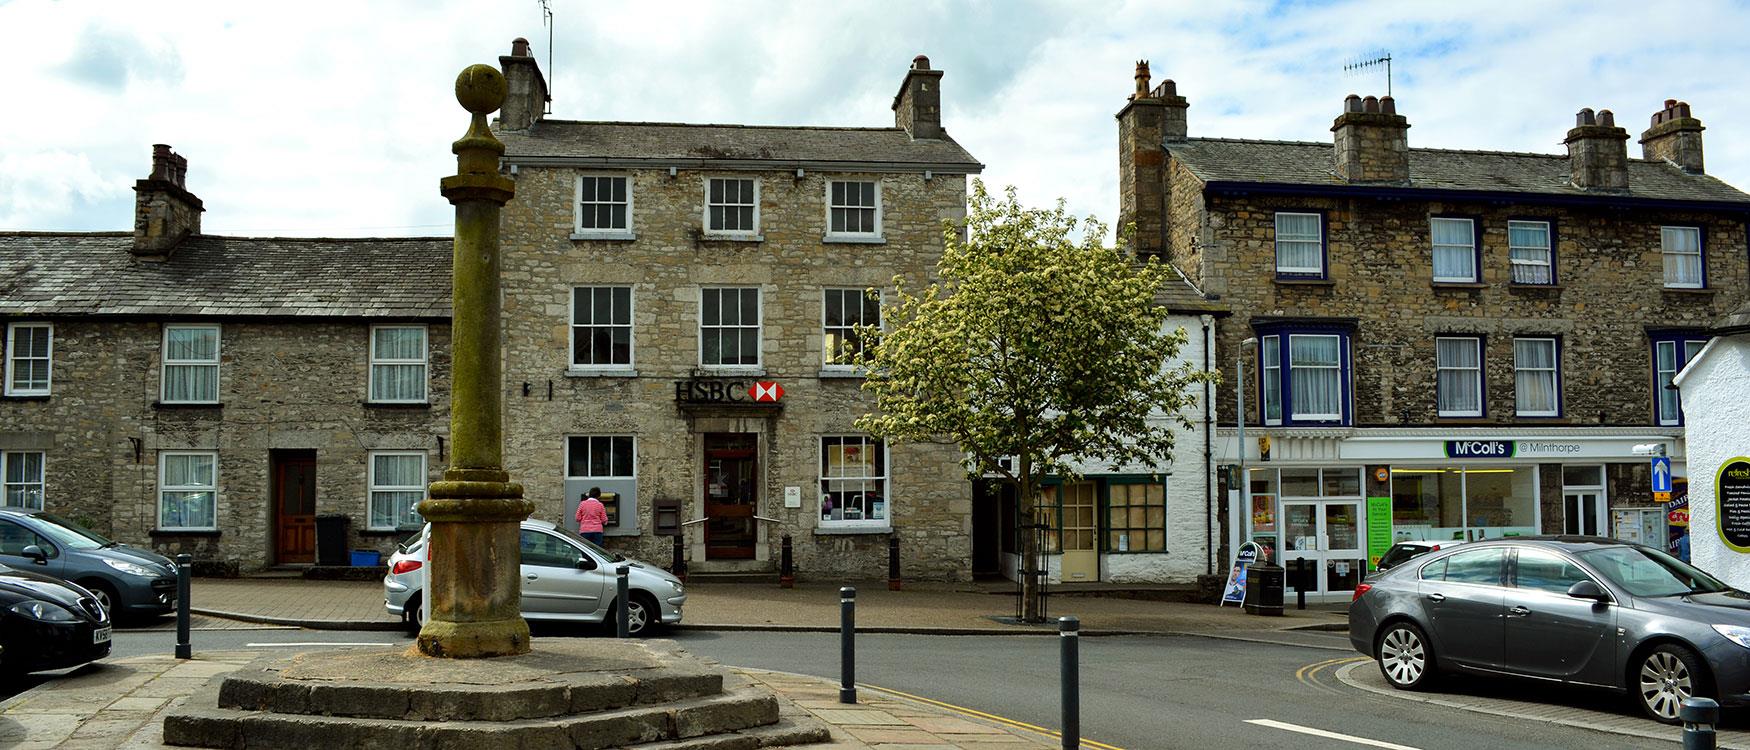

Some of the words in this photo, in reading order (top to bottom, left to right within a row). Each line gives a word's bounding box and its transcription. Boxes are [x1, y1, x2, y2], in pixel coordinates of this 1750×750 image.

[674, 381, 744, 401] HSBC
[1455, 441, 1505, 455] McColl's
[1530, 443, 1580, 454] Milnthorpe
[1668, 495, 1688, 508] DAIR
[1668, 511, 1689, 522] Cru
